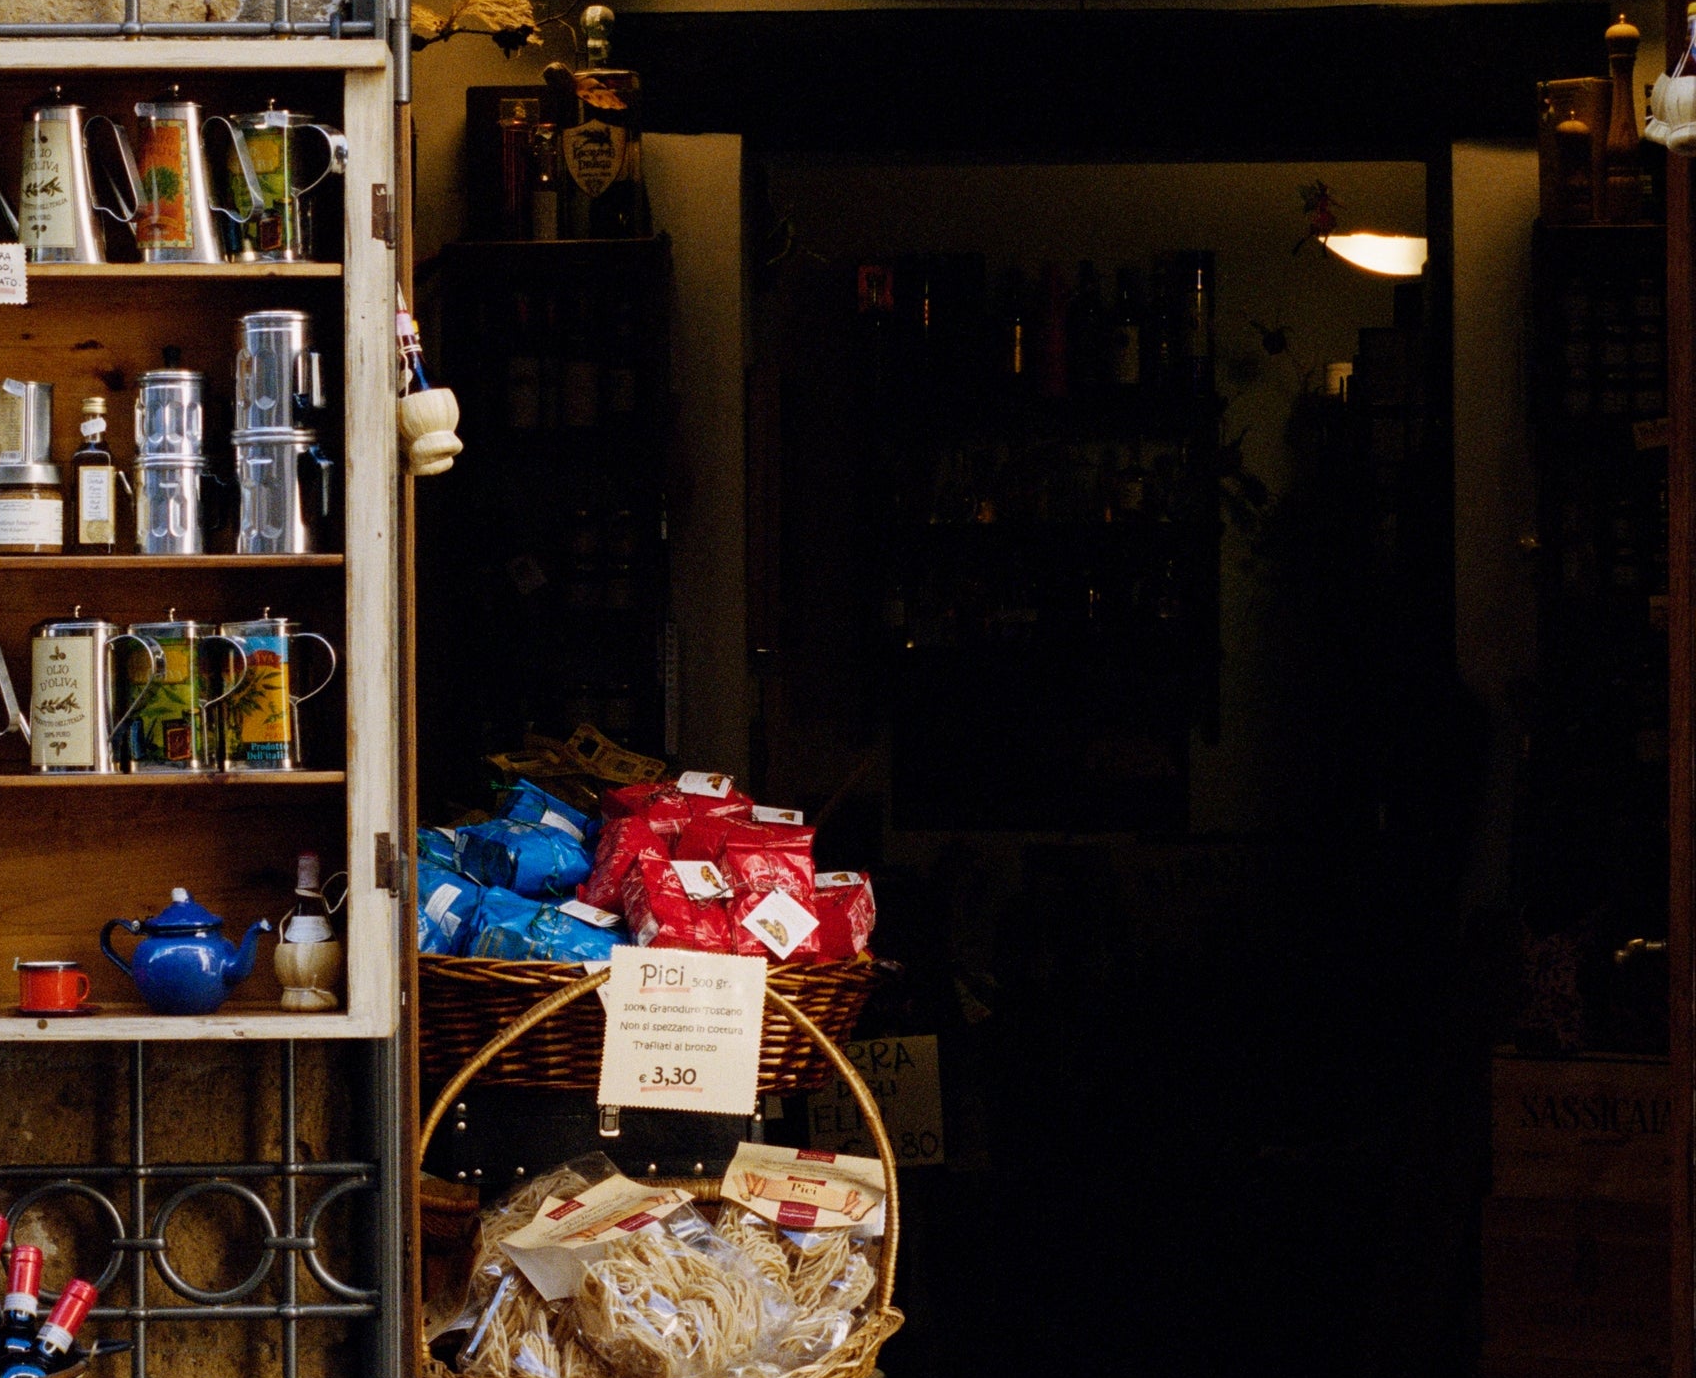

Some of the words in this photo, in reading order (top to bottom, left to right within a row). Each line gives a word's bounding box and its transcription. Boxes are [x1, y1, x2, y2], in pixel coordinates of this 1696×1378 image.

[46, 664, 69, 675] OLIO
[40, 678, 78, 691] D'OLIVA
[640, 964, 685, 987] Pici
[692, 978, 712, 988] 500
[716, 979, 732, 990] gr.
[624, 1003, 647, 1012] 100%
[649, 1003, 700, 1014] Granoduro
[703, 1006, 742, 1016] Toscano
[620, 1021, 640, 1030] Non
[642, 1023, 649, 1031] si
[653, 1024, 693, 1033] spezzano
[697, 1025, 704, 1033] in
[707, 1027, 743, 1035] cottura
[633, 1040, 672, 1050] Trafilati
[674, 1043, 682, 1051] al
[685, 1043, 717, 1052] bronzo
[639, 1073, 647, 1083] €
[652, 1066, 696, 1086] 3,30
[791, 1182, 817, 1195] Pici
